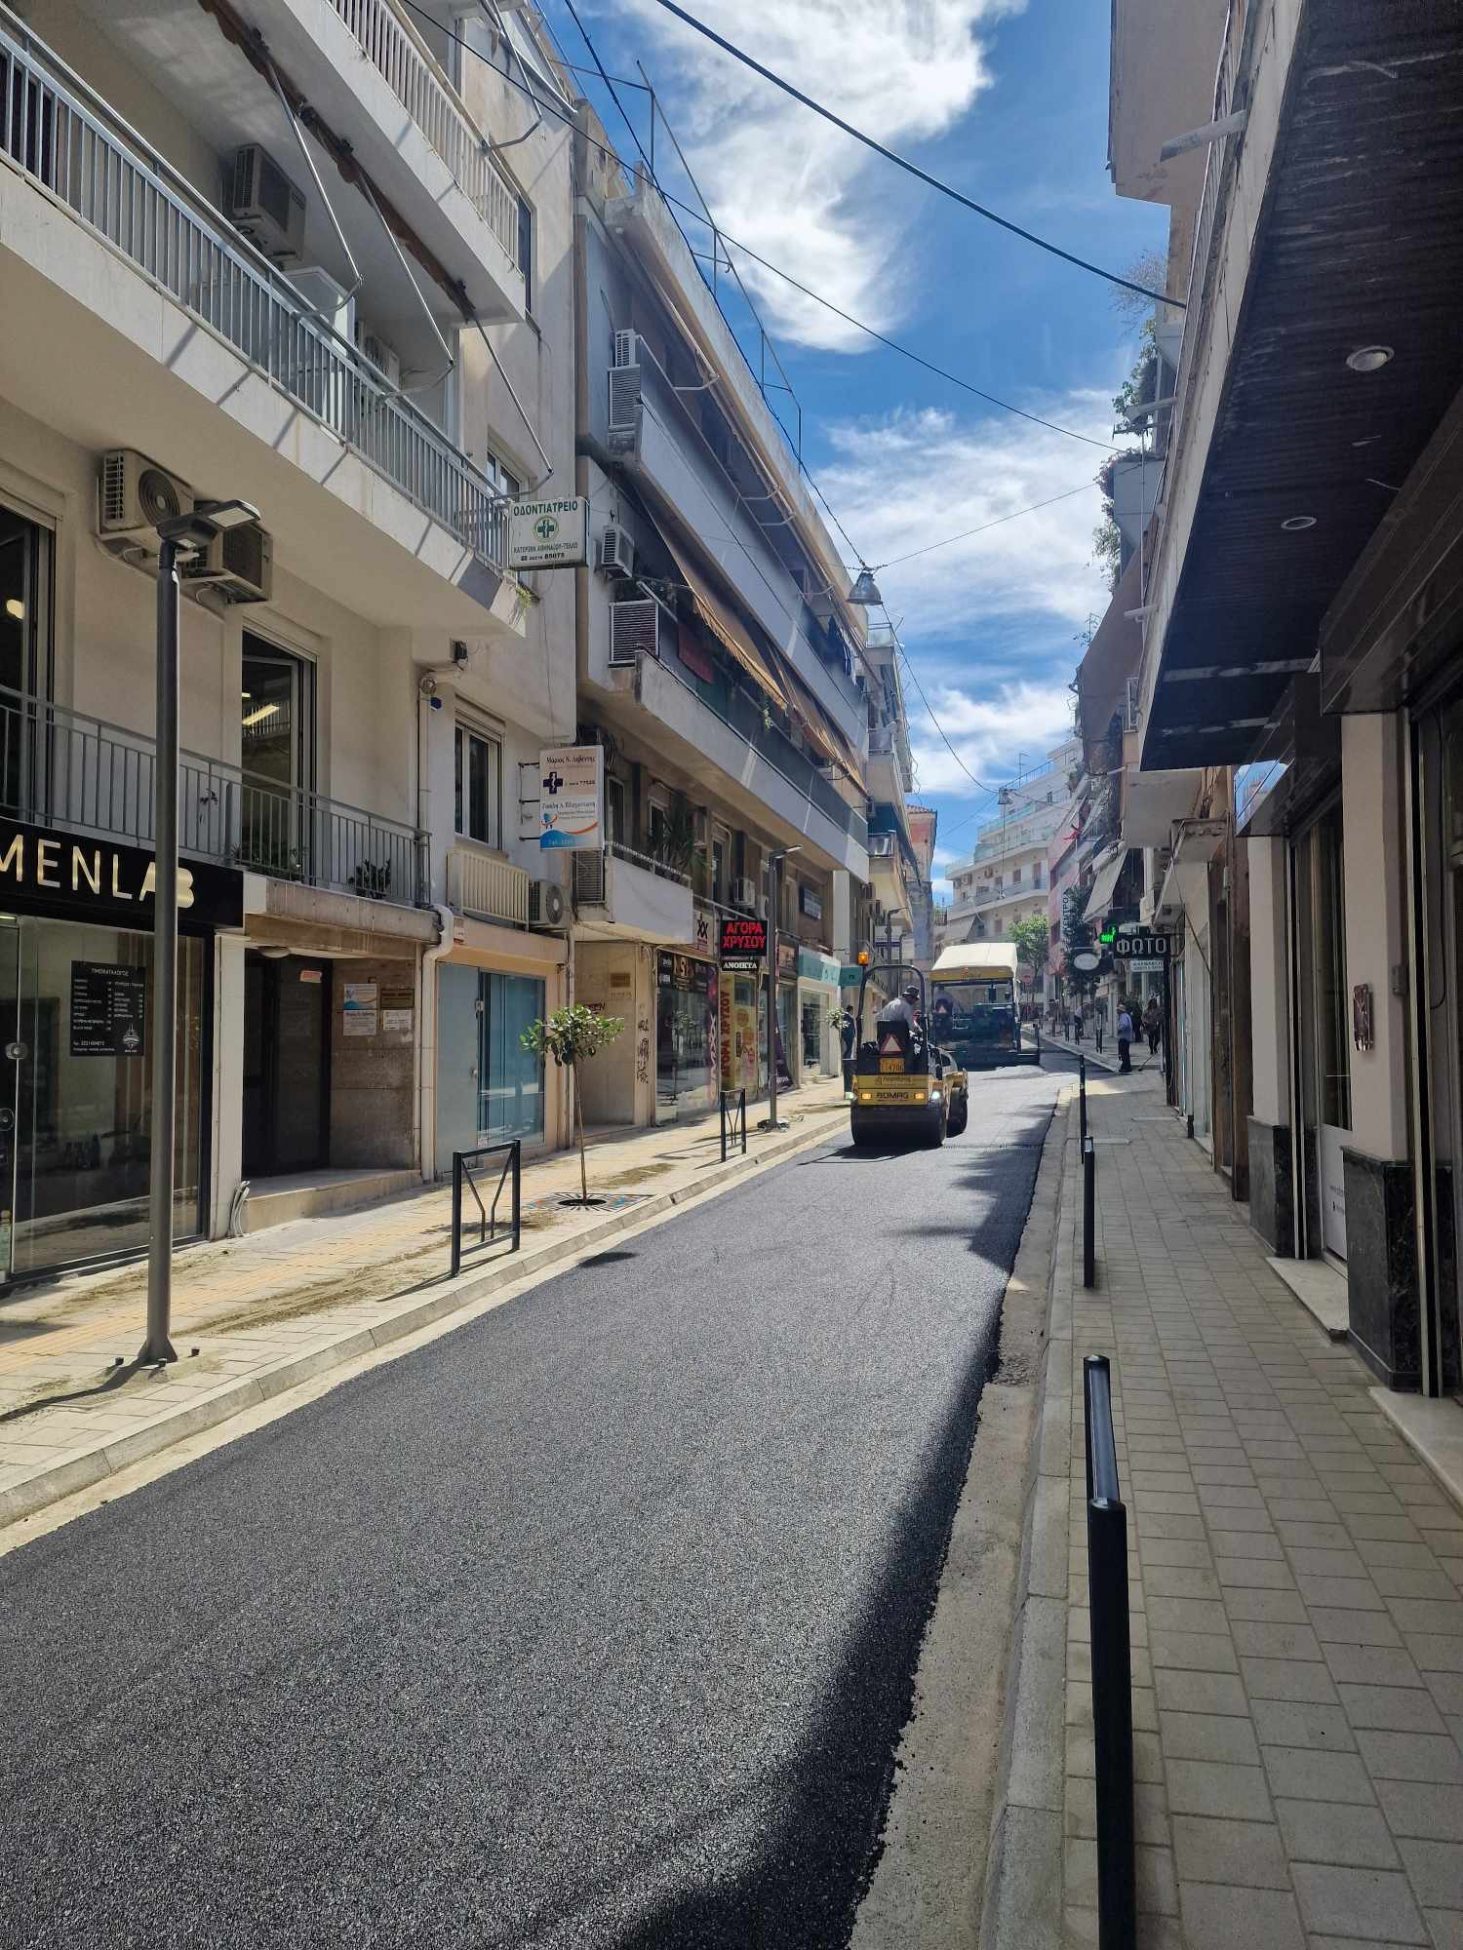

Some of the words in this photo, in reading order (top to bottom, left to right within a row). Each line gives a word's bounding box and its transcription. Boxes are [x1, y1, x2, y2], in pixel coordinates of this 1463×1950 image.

[513, 501, 578, 517] ΟΔΟΝΤΙΑΤΡΕΙΟ
[726, 922, 764, 935] ΑΓΟΡΑ
[722, 935, 766, 949] ΧΡΥΣΟΥ
[1116, 938, 1167, 955] ΦΩΤΟ
